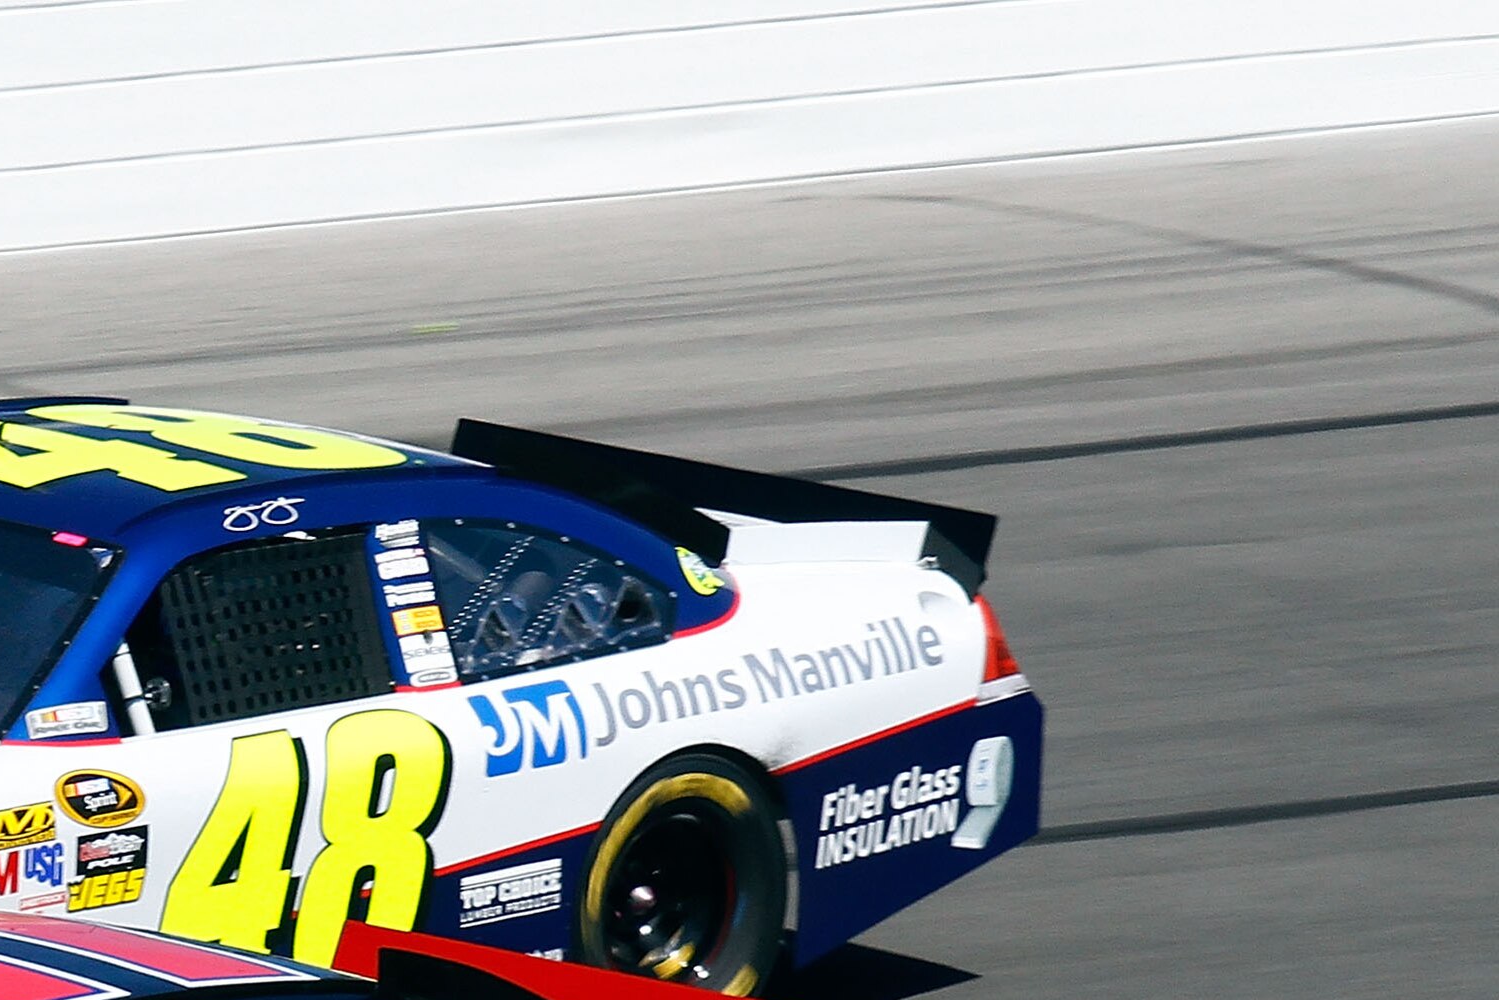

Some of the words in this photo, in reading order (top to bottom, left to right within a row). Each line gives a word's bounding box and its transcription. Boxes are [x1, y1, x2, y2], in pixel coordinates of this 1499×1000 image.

[592, 668, 748, 747] Johns
[742, 617, 943, 704] Manville
[468, 679, 588, 777] JM
[819, 783, 889, 831] Fiber
[891, 765, 962, 810] Glass
[25, 842, 64, 887] USG
[86, 855, 136, 870] POLE
[160, 708, 453, 969] 48
[814, 798, 960, 870] INSULATION
[67, 868, 146, 911] JEGS
[460, 885, 497, 909] TOP
[498, 871, 563, 902] CHOICE
